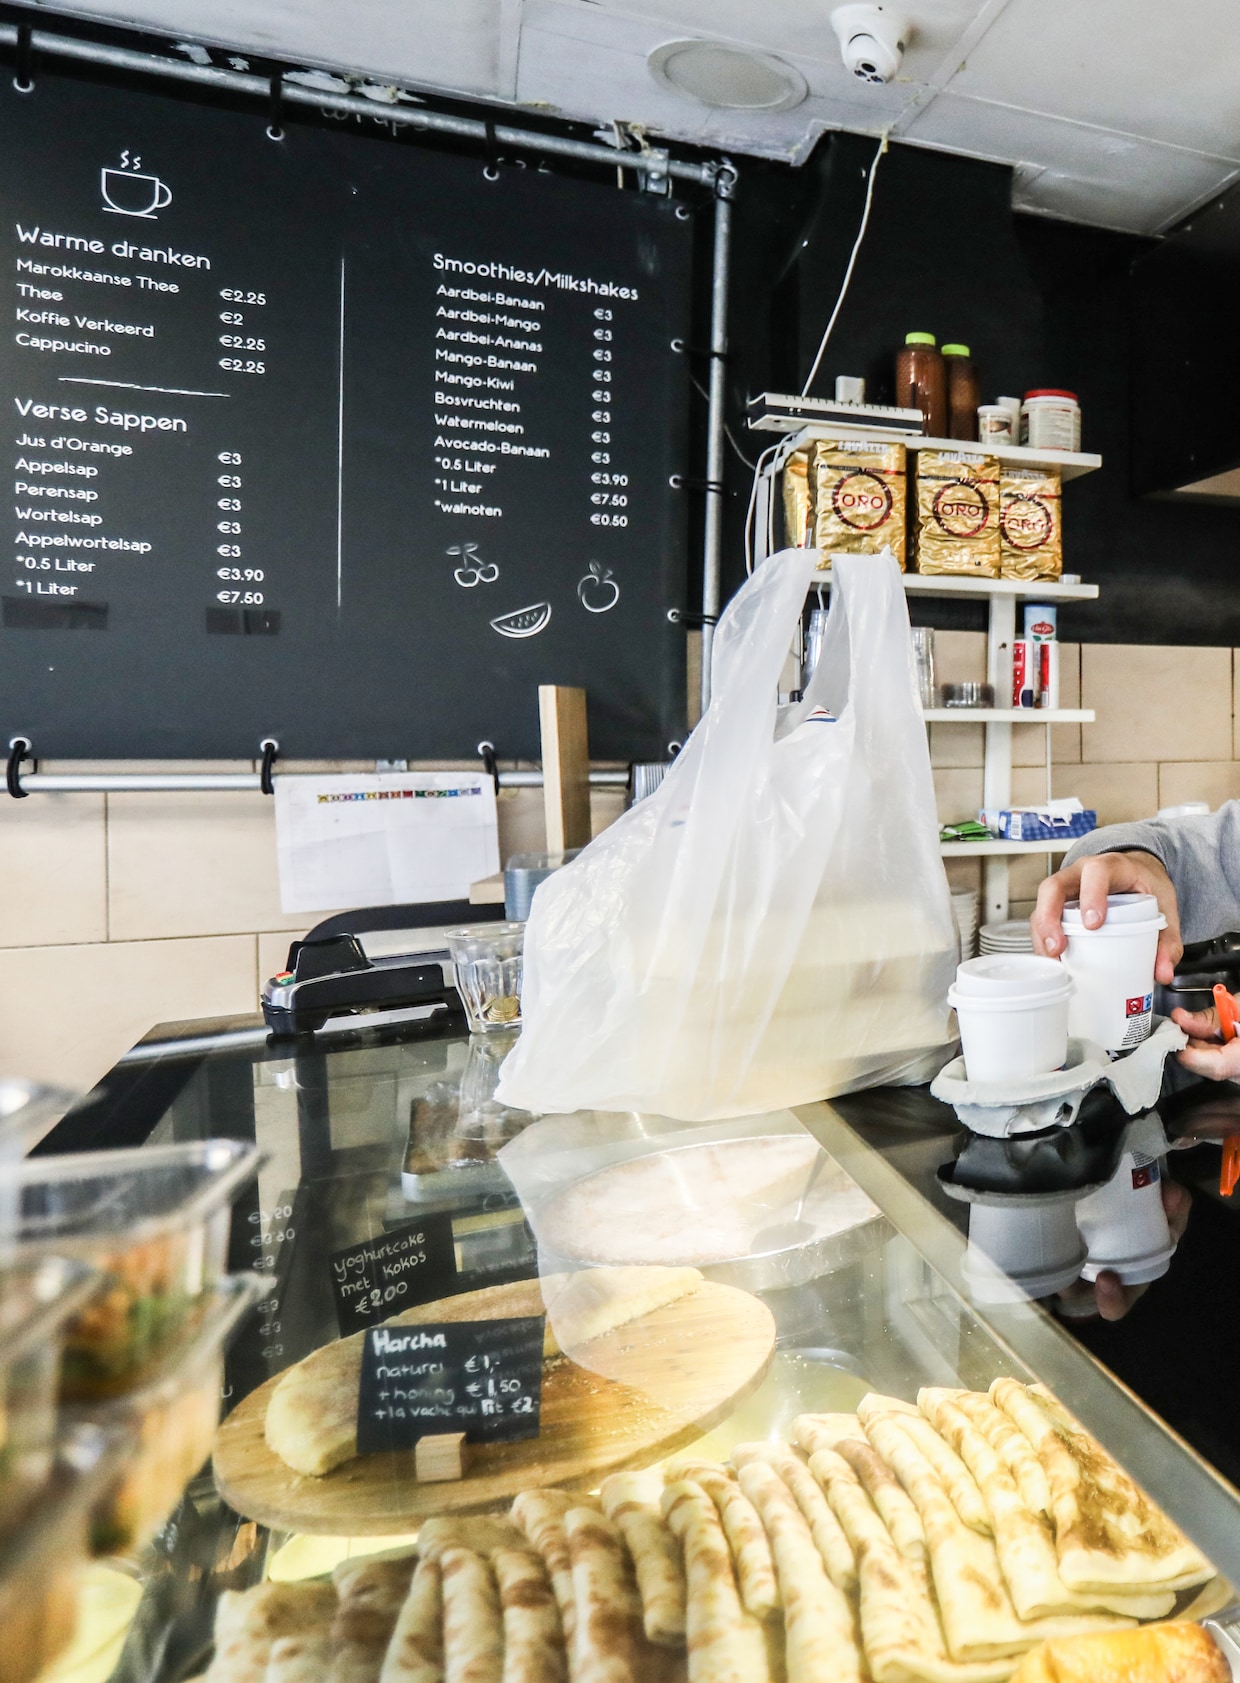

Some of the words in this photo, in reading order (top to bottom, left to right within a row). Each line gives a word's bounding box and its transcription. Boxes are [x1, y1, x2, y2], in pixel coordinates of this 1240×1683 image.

[16, 224, 105, 253] Warme
[112, 241, 211, 270] dranken
[16, 259, 132, 287] Marokkaanse
[136, 275, 180, 294] Thee
[219, 288, 266, 305] €2.25
[433, 253, 639, 301] Smoothies/Milkshakes
[16, 283, 64, 302] Thee
[219, 311, 244, 326] €2
[436, 284, 545, 311] Aardbei-Banaan
[593, 308, 613, 321] €3
[16, 308, 71, 327] Koffie
[74, 316, 154, 337] Verkeerd
[219, 335, 266, 351] €2.25
[435, 306, 541, 333] Aardbei-Mango
[593, 328, 613, 342] €3
[15, 333, 111, 356] Cappucino
[219, 358, 266, 374] €2.25
[435, 327, 543, 352] Aardbei-Ananas
[592, 349, 612, 362] €3
[435, 348, 537, 373] Mango-Banaan
[592, 369, 612, 382] €3
[434, 370, 515, 391] Mango-Kiwi
[592, 389, 611, 403] €3
[15, 398, 88, 422] Verse
[95, 406, 187, 432] Sappen
[434, 392, 521, 413] Bosvruchten
[591, 410, 611, 424] €3
[434, 413, 524, 435] Watermeloen
[591, 431, 611, 444] €3
[16, 434, 46, 448] Jus
[51, 436, 133, 457] d'Orange
[217, 452, 242, 465] €3
[434, 435, 550, 458] Avocado-Banaan
[591, 452, 611, 464] €3
[15, 458, 98, 479] Appelsap
[217, 475, 242, 488] €3
[465, 459, 497, 474] Liter
[590, 472, 629, 487] €3.90
[15, 482, 99, 502] Perensap
[217, 498, 242, 512] €3
[451, 481, 483, 494] Liter
[590, 493, 628, 507] €7.50
[842, 494, 883, 509] ORO
[942, 503, 980, 516] ORO
[15, 507, 103, 527] Wortelsap
[217, 521, 242, 535] €3
[590, 513, 628, 528] €0.50
[14, 531, 152, 554] Appelwortelsap
[217, 544, 242, 558] €3
[55, 559, 96, 573] Liter
[217, 568, 264, 582] €3.90
[37, 582, 78, 596] Liter
[217, 591, 264, 605] €7.50
[341, 1276, 371, 1297] met
[372, 1329, 447, 1356] Harcha
